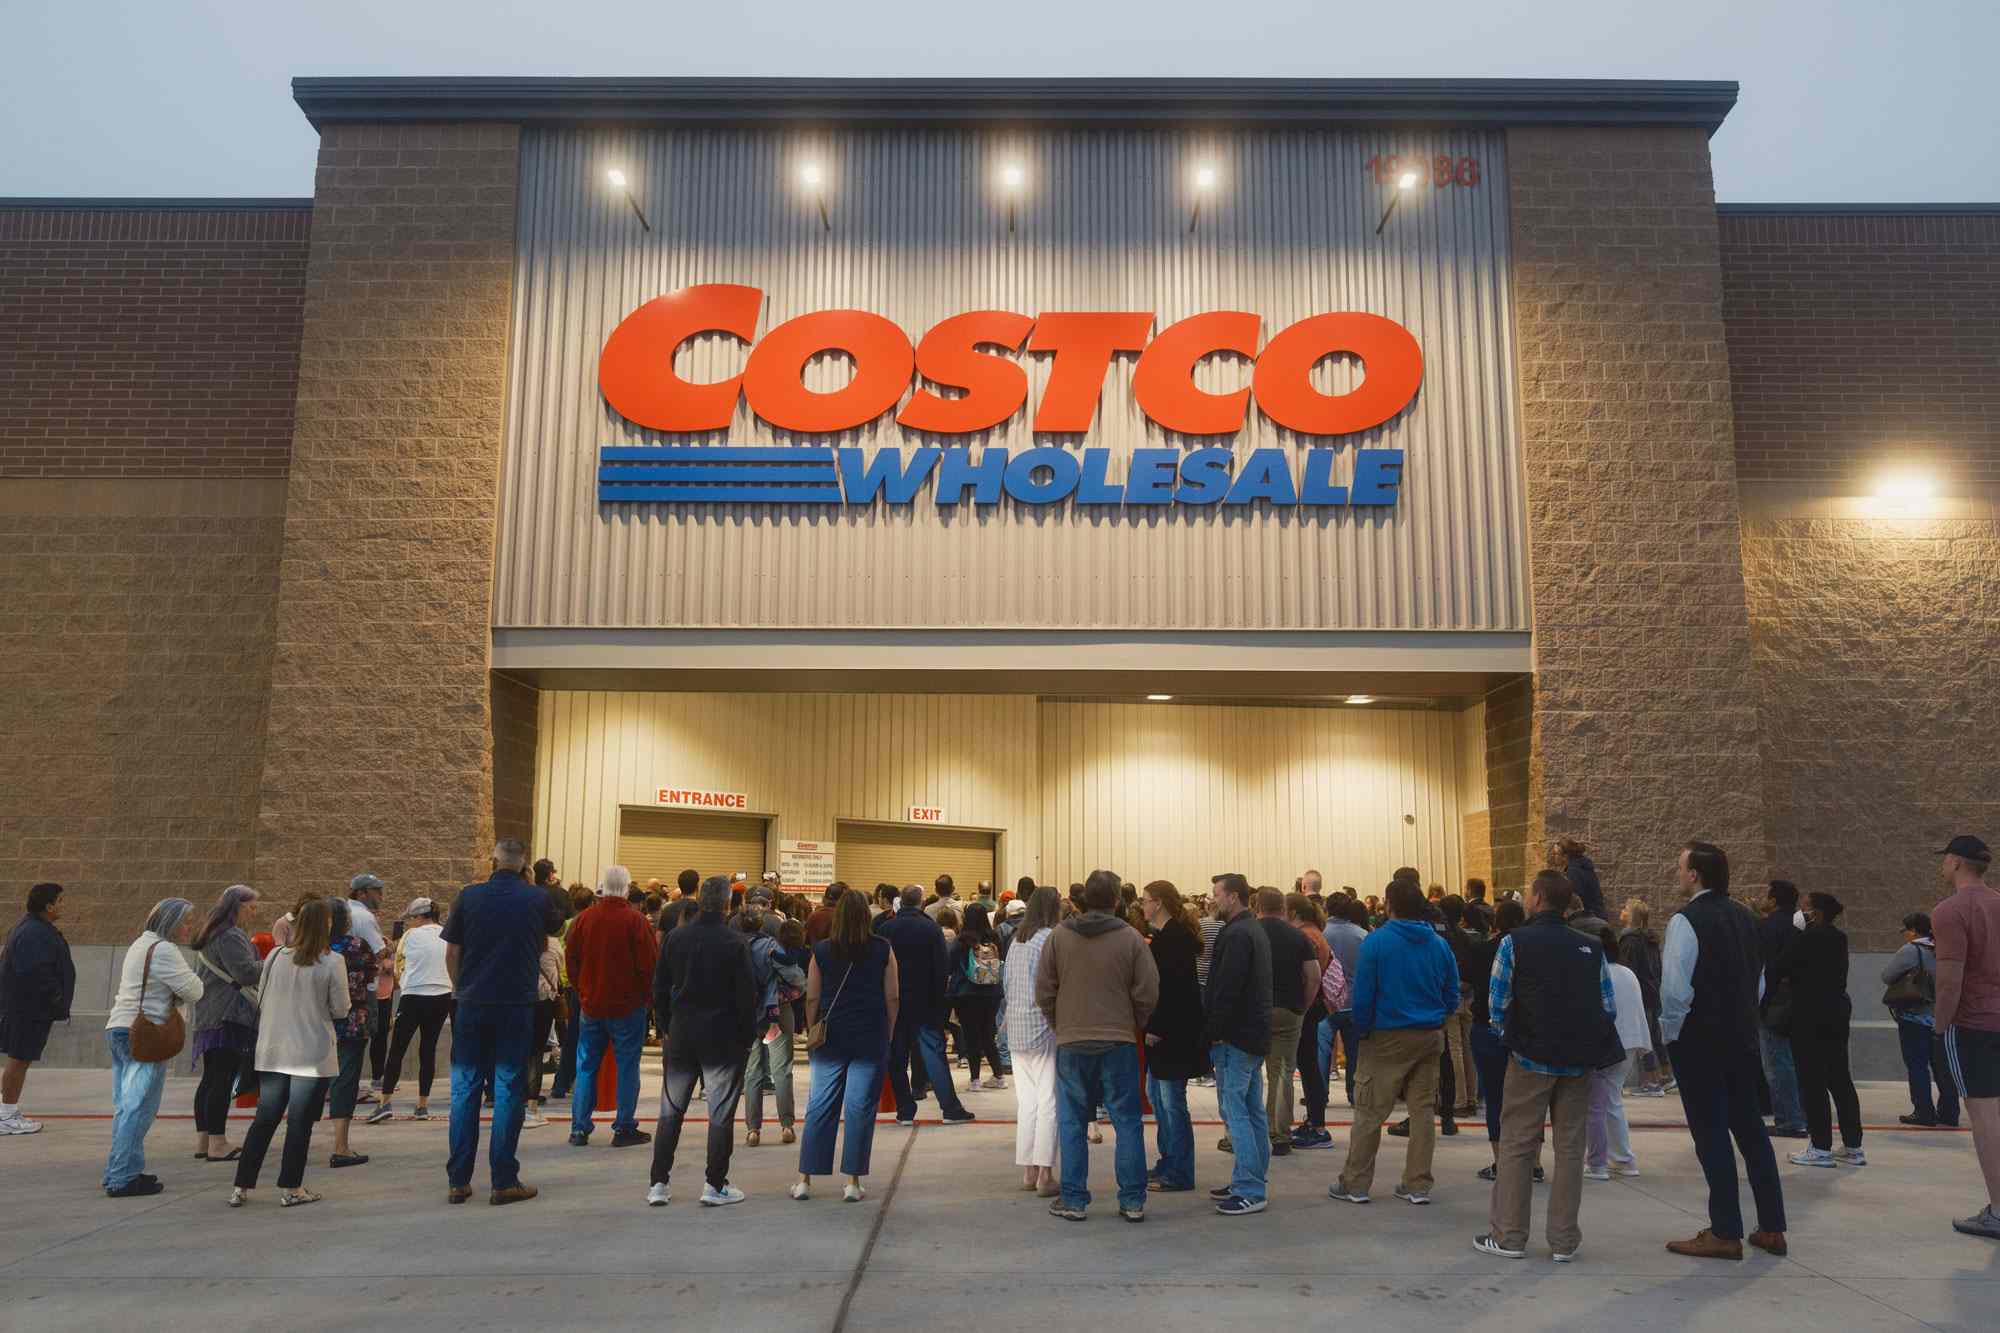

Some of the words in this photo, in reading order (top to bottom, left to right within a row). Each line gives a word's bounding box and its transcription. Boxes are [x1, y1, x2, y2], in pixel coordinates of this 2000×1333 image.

[598, 283, 1424, 435] COSTCO
[840, 447, 1403, 507] WHOLESALE
[659, 789, 745, 808] ENTRANCE
[913, 808, 942, 821] EXIT
